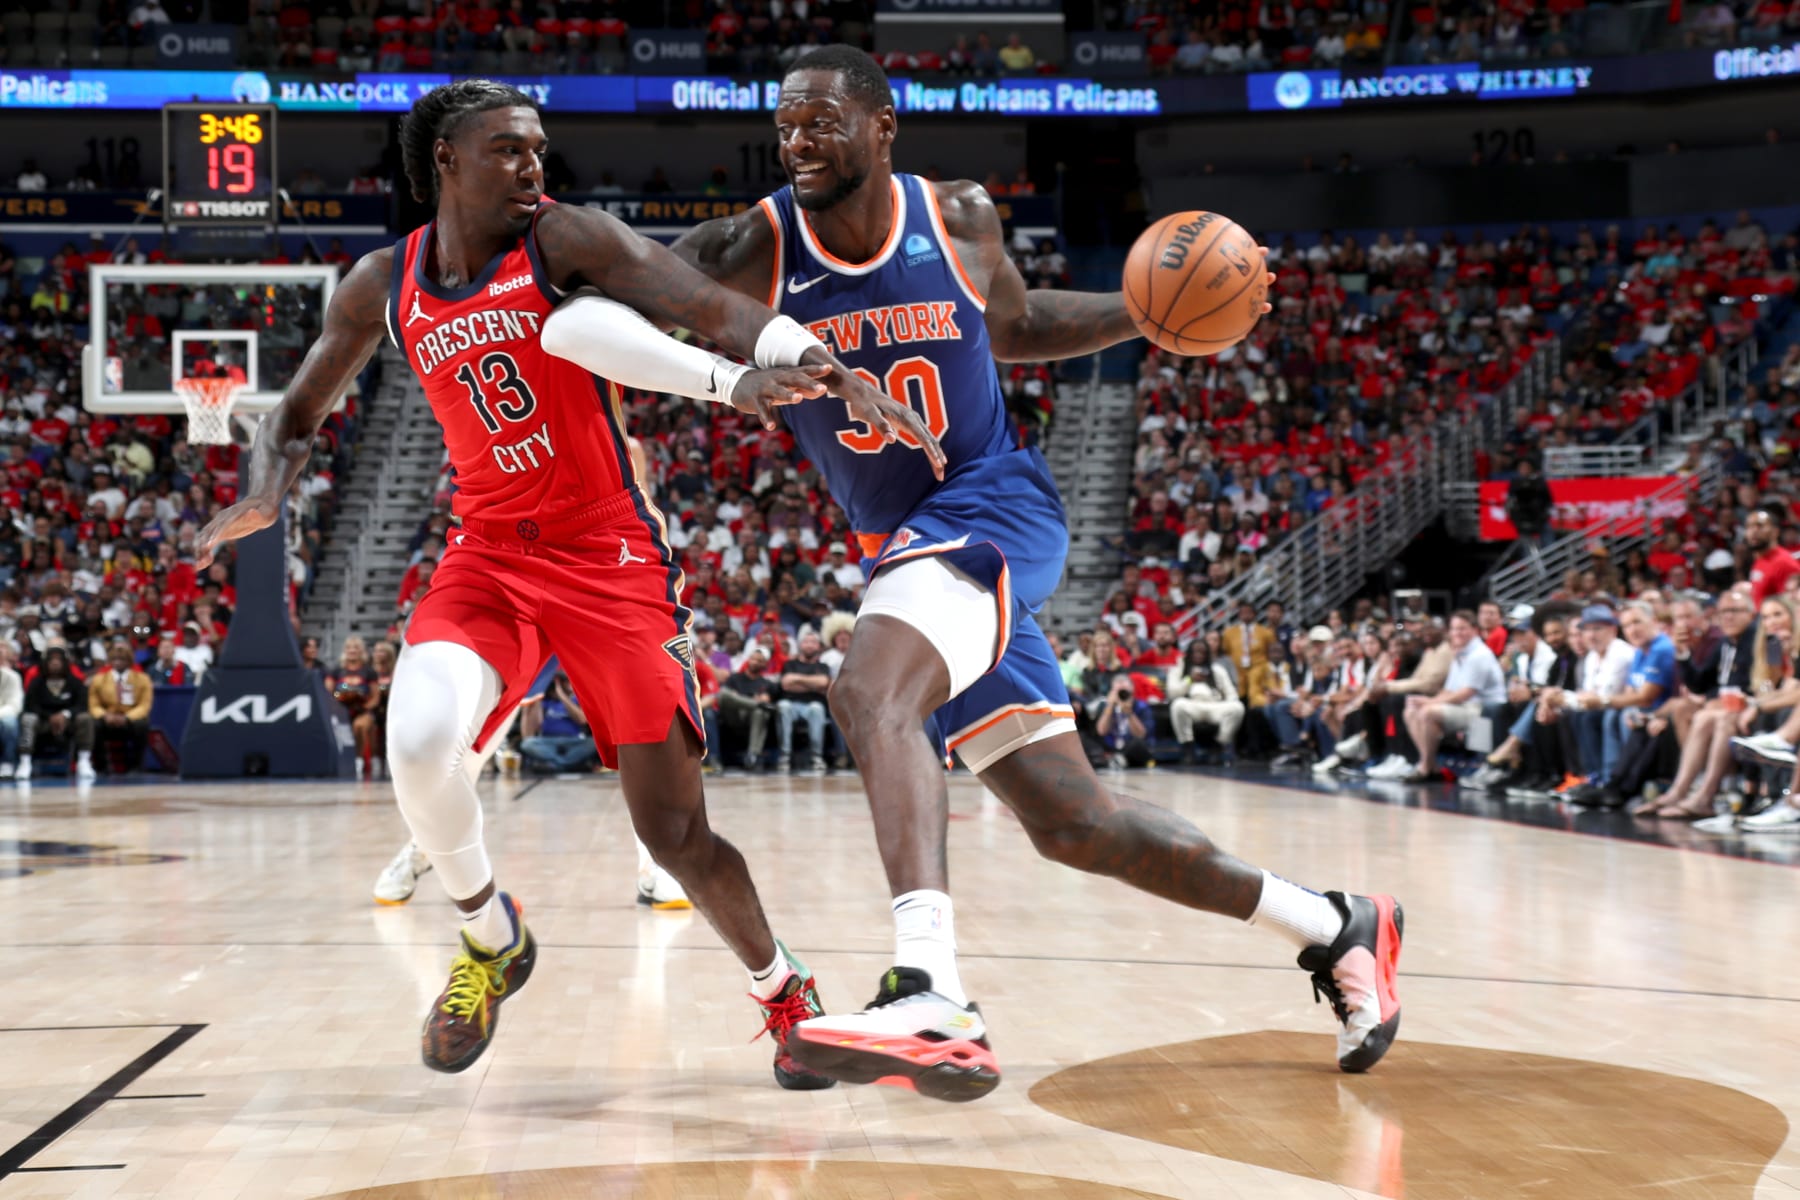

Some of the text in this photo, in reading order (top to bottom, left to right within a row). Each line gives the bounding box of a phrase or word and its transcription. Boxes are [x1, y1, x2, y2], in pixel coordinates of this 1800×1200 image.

[187, 37, 230, 54] HUB
[660, 41, 702, 59] HUB
[1101, 44, 1142, 61] HUB
[1714, 42, 1800, 80] Official
[1, 75, 108, 104] Pelicans
[280, 82, 410, 103] HANCOCK
[672, 80, 761, 110] Official
[905, 81, 955, 110] New
[961, 82, 1051, 111] Orleans
[1056, 83, 1158, 111] Pelicans
[1321, 67, 1592, 99] HANCOCK WHITNEY
[200, 113, 262, 144] 3:46
[208, 144, 254, 193] 19
[0, 199, 67, 216] ERS
[200, 202, 269, 216] TISSOT
[489, 273, 533, 297] ibotta
[803, 301, 962, 353] EW YORK
[414, 309, 540, 376] CRESCENT
[455, 351, 537, 434] 13
[492, 422, 556, 474] CITY
